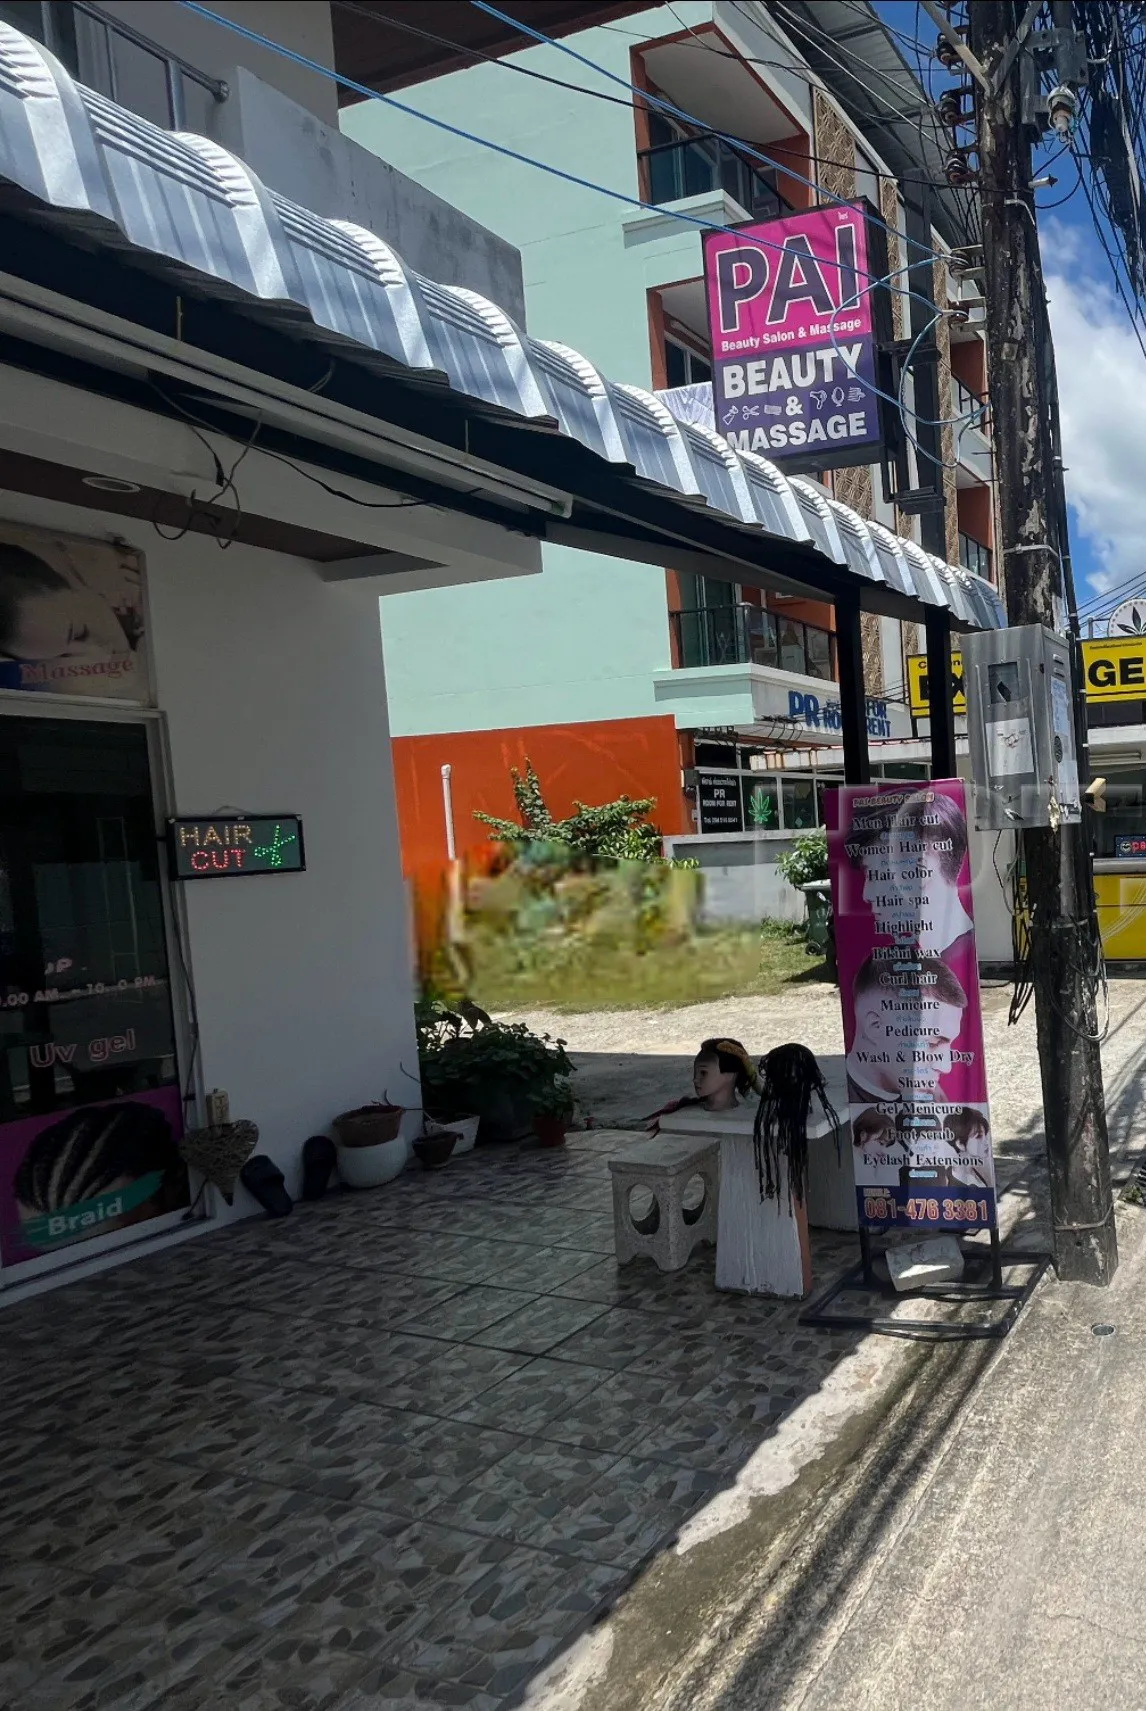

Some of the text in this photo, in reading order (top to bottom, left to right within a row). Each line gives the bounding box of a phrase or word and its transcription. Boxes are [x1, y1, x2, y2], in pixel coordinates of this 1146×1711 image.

[716, 223, 861, 334] PAI
[721, 318, 861, 352] Beauty Salon & Massage
[723, 343, 863, 399] BEAUTY
[785, 396, 803, 416] &
[726, 412, 867, 452] MASSAGE
[20, 660, 134, 684] Massage
[788, 690, 820, 727] PR
[714, 788, 726, 799] PR
[853, 813, 940, 830] Men Hair cut
[180, 825, 252, 846] HAIR
[845, 838, 953, 858] Women Hair cut
[191, 849, 246, 871] CUT
[868, 867, 933, 881] Hair color
[876, 895, 929, 909] Hair spa
[875, 920, 933, 935] Highlight
[872, 946, 941, 960] Bikini wax
[910, 971, 938, 985] hair
[881, 999, 940, 1012] Manicure
[885, 1024, 940, 1037] Pedicure
[30, 1028, 136, 1068] Uv gel
[856, 1049, 975, 1066] Wash & Blow Dry
[898, 1076, 935, 1088] Shave
[876, 1102, 963, 1115] Gel Menicure
[887, 1127, 955, 1141] Foot scrub
[863, 1153, 984, 1168] Eyelash Extensions
[48, 1196, 124, 1237] Braid
[864, 1198, 988, 1221] 081-476 3381
